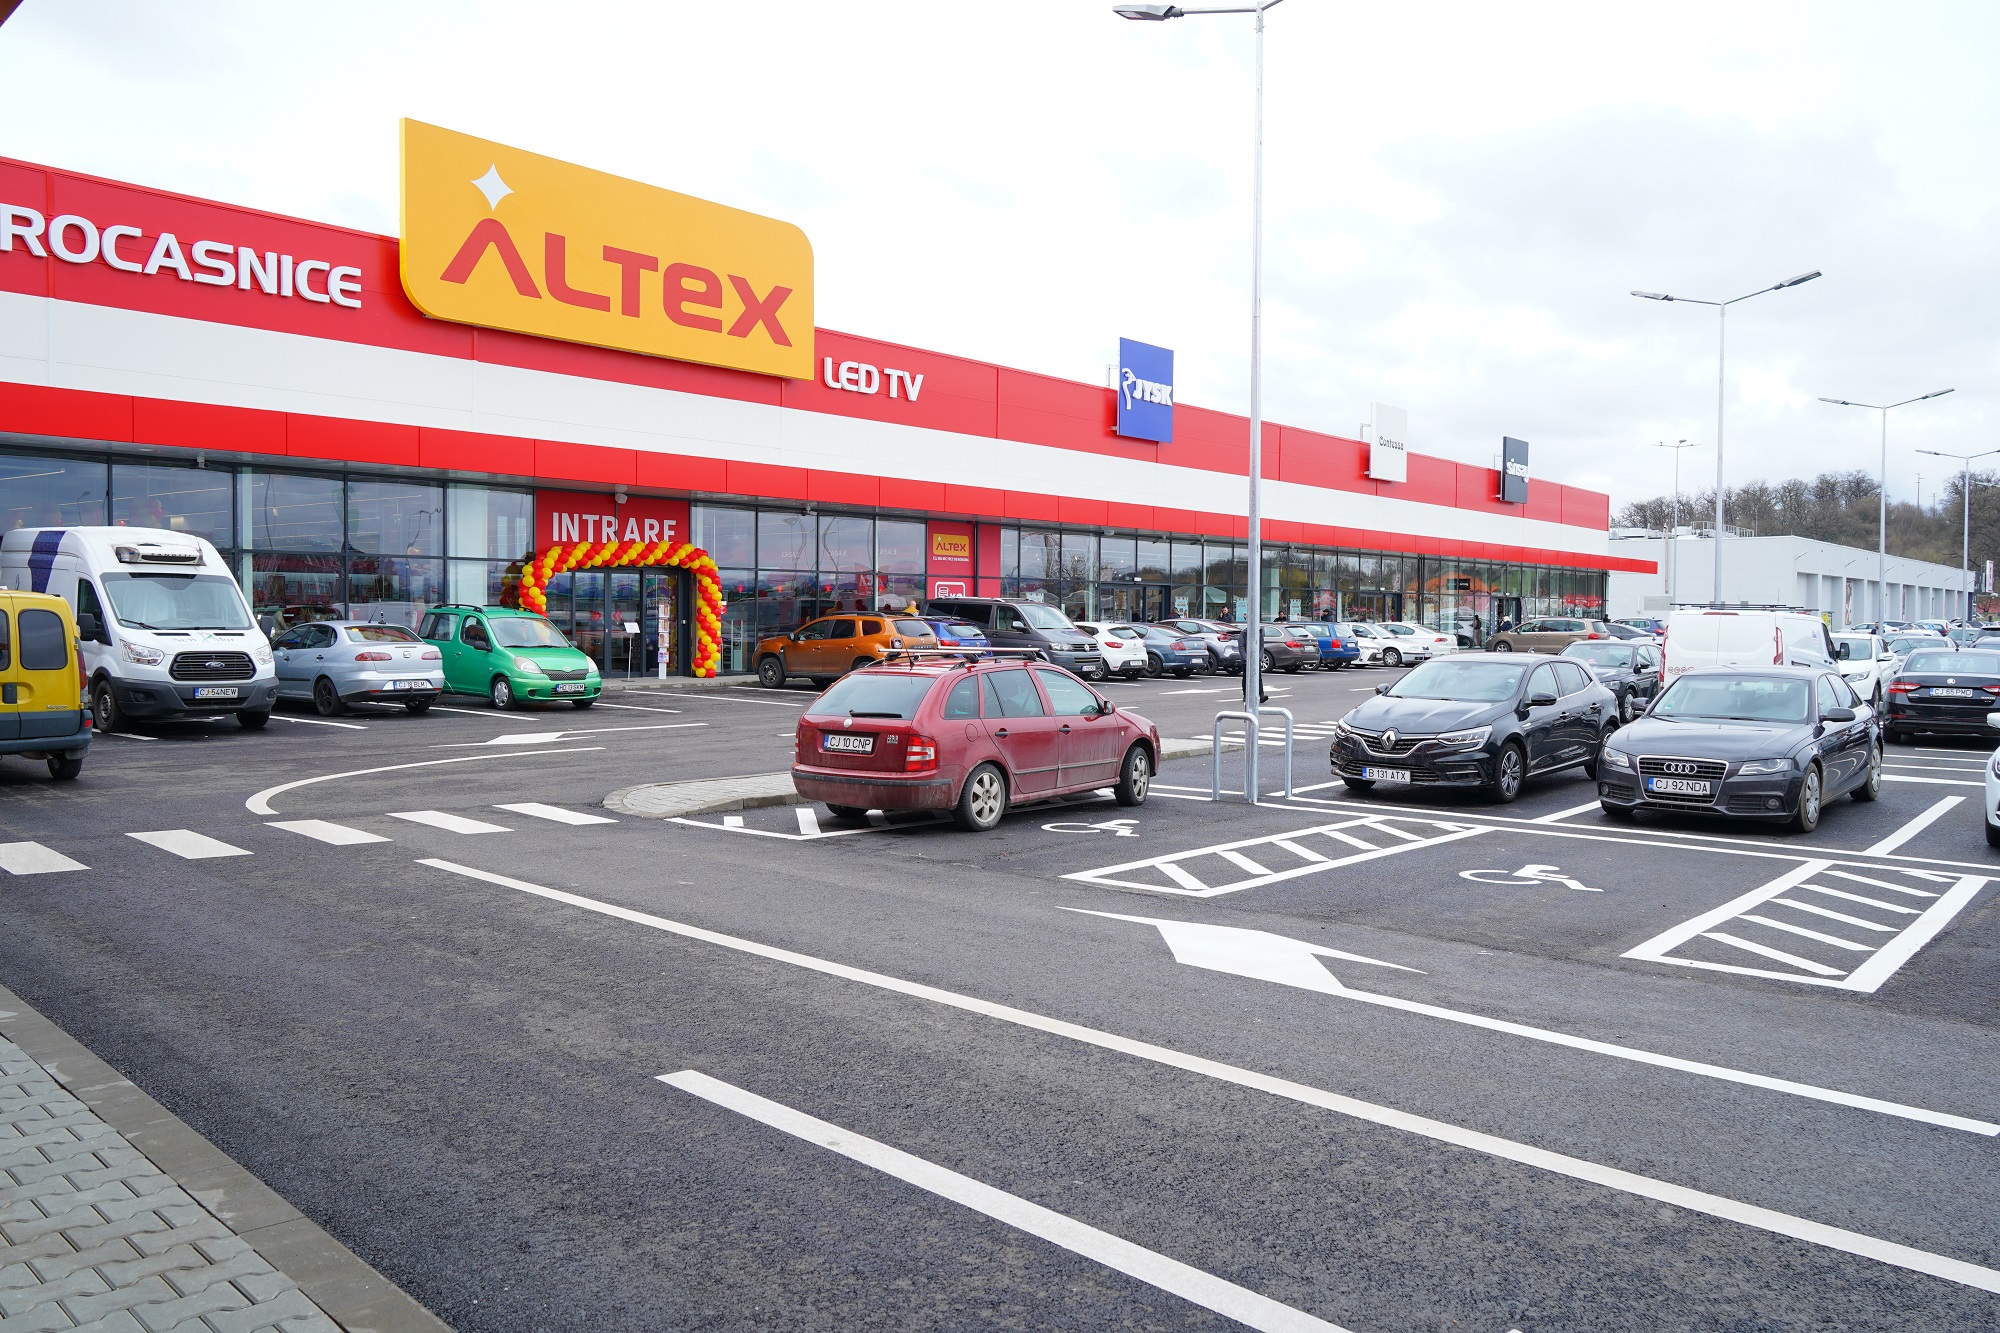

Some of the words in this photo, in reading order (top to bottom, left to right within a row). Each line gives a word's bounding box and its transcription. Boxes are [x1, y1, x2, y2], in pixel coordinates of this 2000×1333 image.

[0, 203, 362, 309] ROCASNICE
[824, 357, 880, 395] LED
[884, 367, 924, 402] TV
[1132, 378, 1173, 407] JYSK
[1379, 435, 1404, 451] Contessa
[552, 511, 677, 544] INTRARE
[200, 688, 209, 696] CJ
[829, 736, 841, 748] CJ
[842, 737, 851, 748] 10
[852, 738, 871, 750] CNP
[1368, 768, 1375, 778] B
[1377, 769, 1388, 779] 131
[1390, 771, 1406, 781] ATX
[1655, 779, 1669, 790] CJ
[1671, 780, 1684, 791] 92
[1686, 781, 1708, 793] NDA
